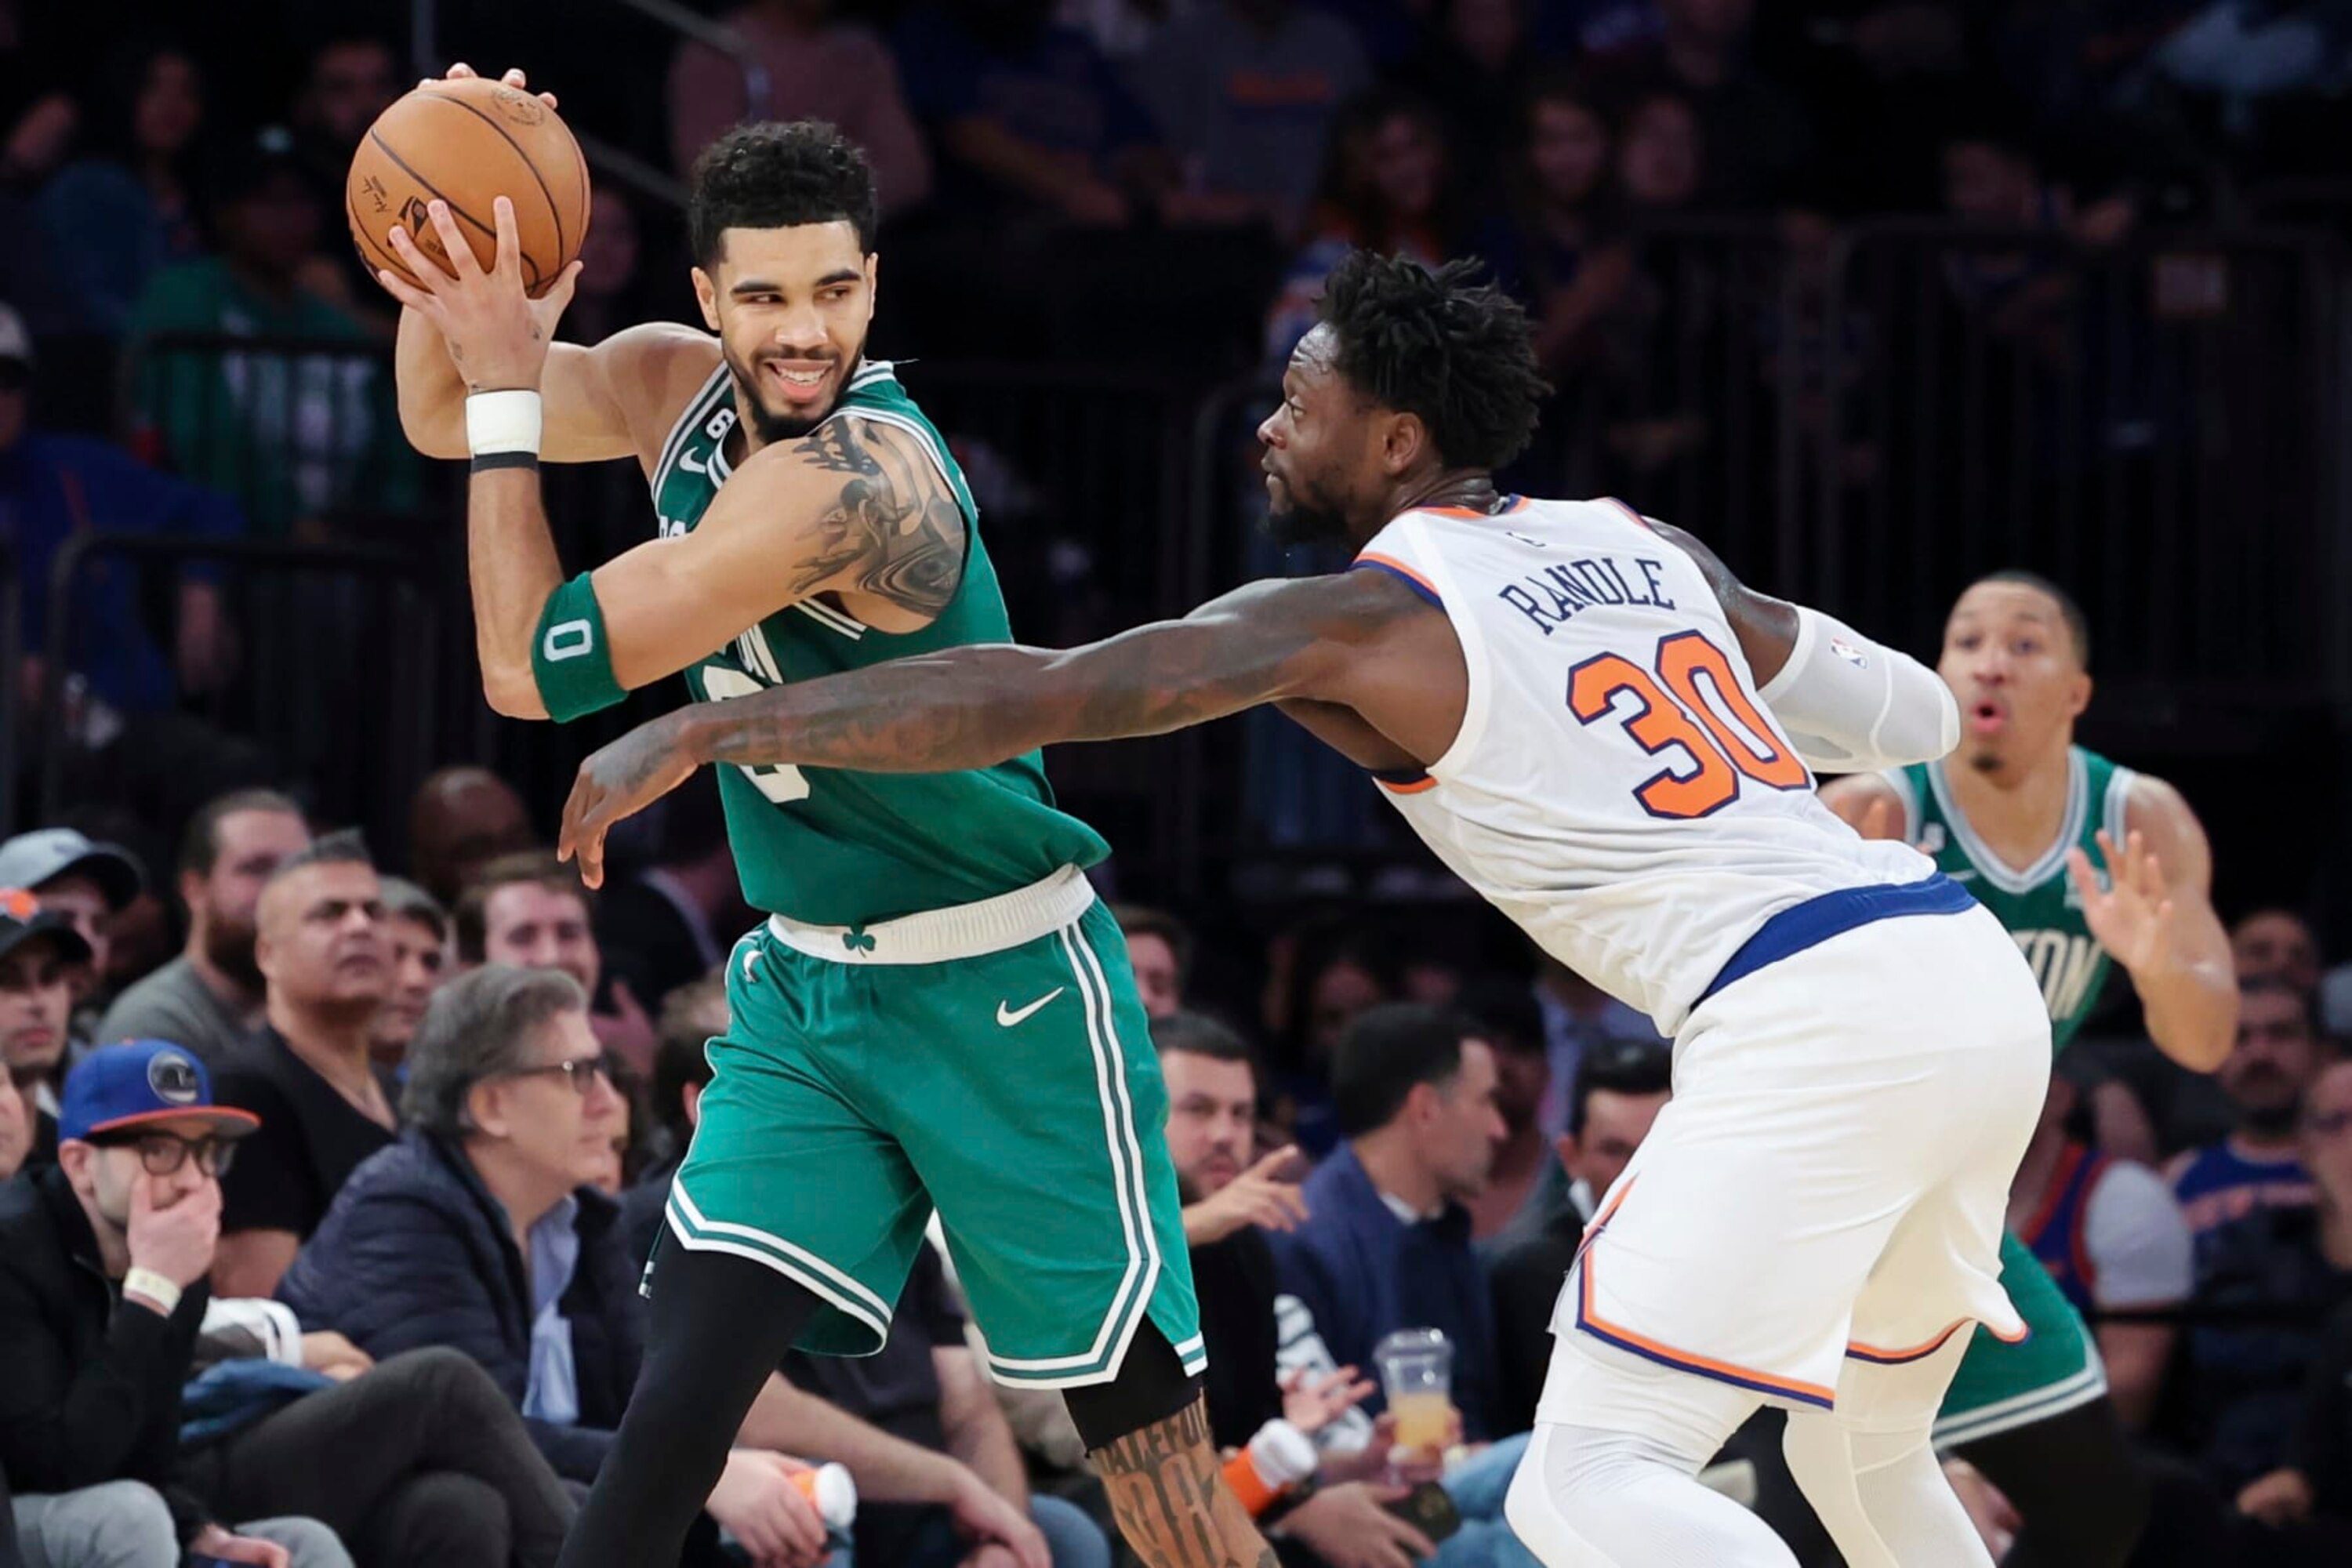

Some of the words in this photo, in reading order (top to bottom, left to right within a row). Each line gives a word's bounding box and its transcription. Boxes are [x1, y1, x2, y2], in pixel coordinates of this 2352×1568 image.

[1498, 557, 1675, 636] RANDLE
[543, 619, 593, 662] 0
[1566, 629, 1812, 819] 30
